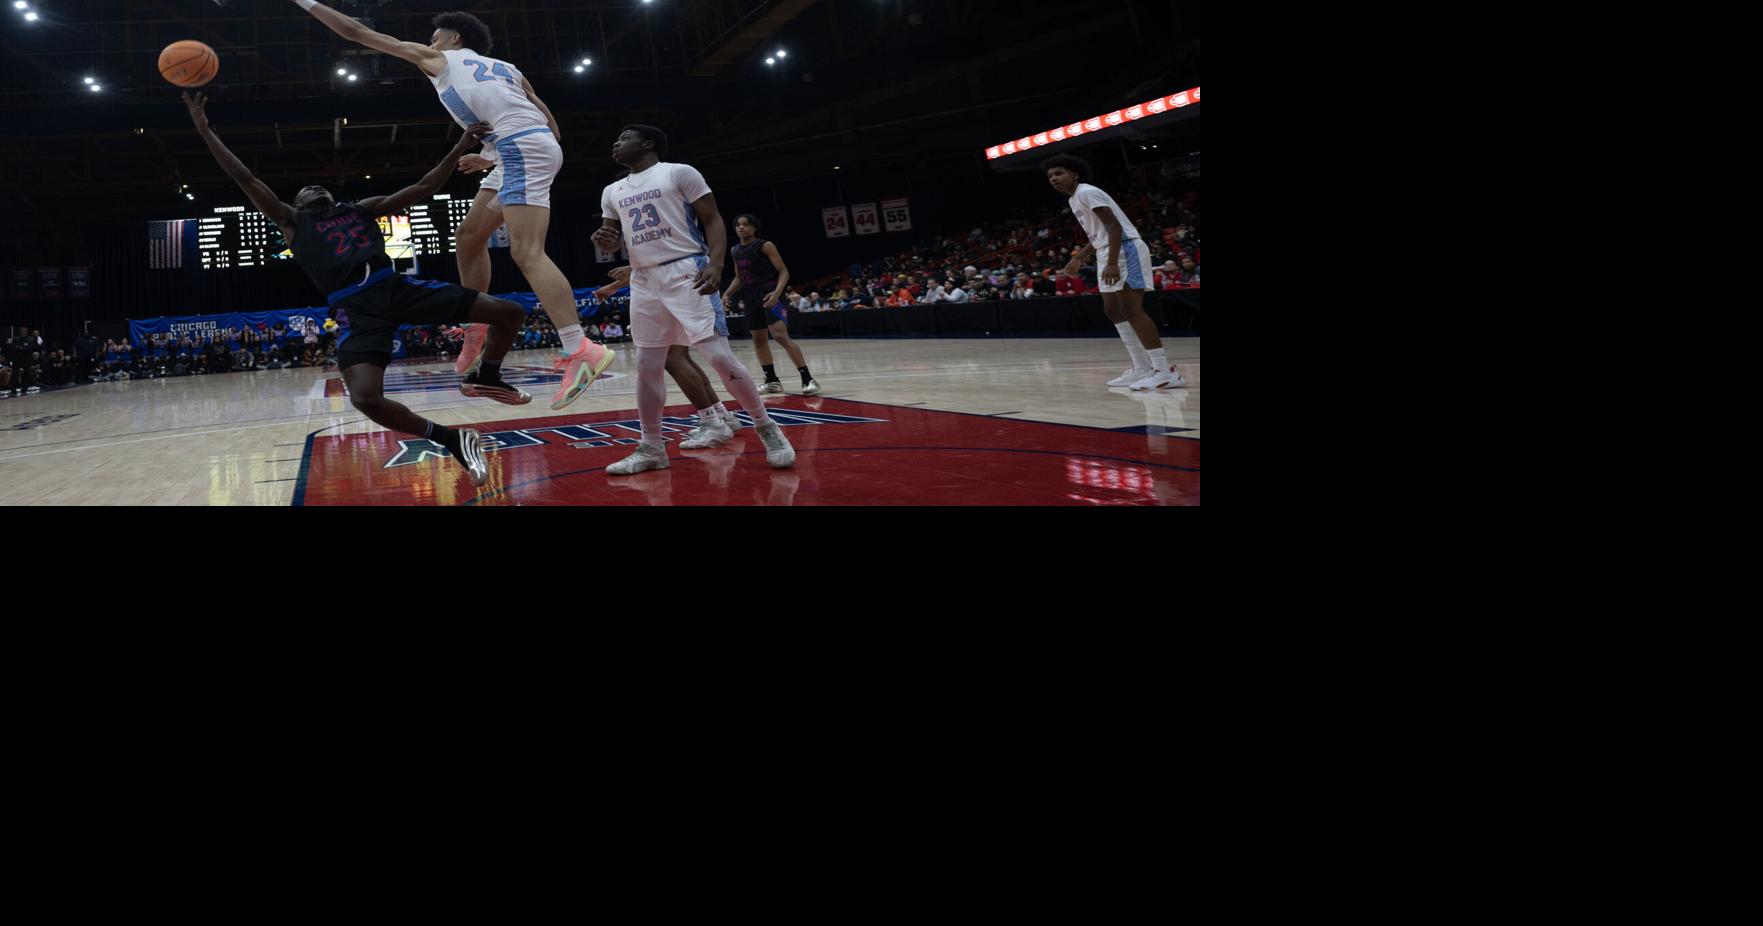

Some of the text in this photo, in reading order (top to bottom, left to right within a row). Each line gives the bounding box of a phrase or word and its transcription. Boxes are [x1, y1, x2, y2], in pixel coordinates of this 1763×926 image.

[463, 59, 514, 84] 24
[619, 189, 662, 208] KENWOOD
[628, 203, 661, 232] 23
[827, 217, 845, 230] 24
[856, 213, 875, 225] 44
[886, 209, 907, 223] 55
[327, 225, 369, 255] 25
[631, 227, 672, 246] ACADEMY
[170, 321, 217, 332] CHICAGO
[152, 332, 191, 341] PBLIC
